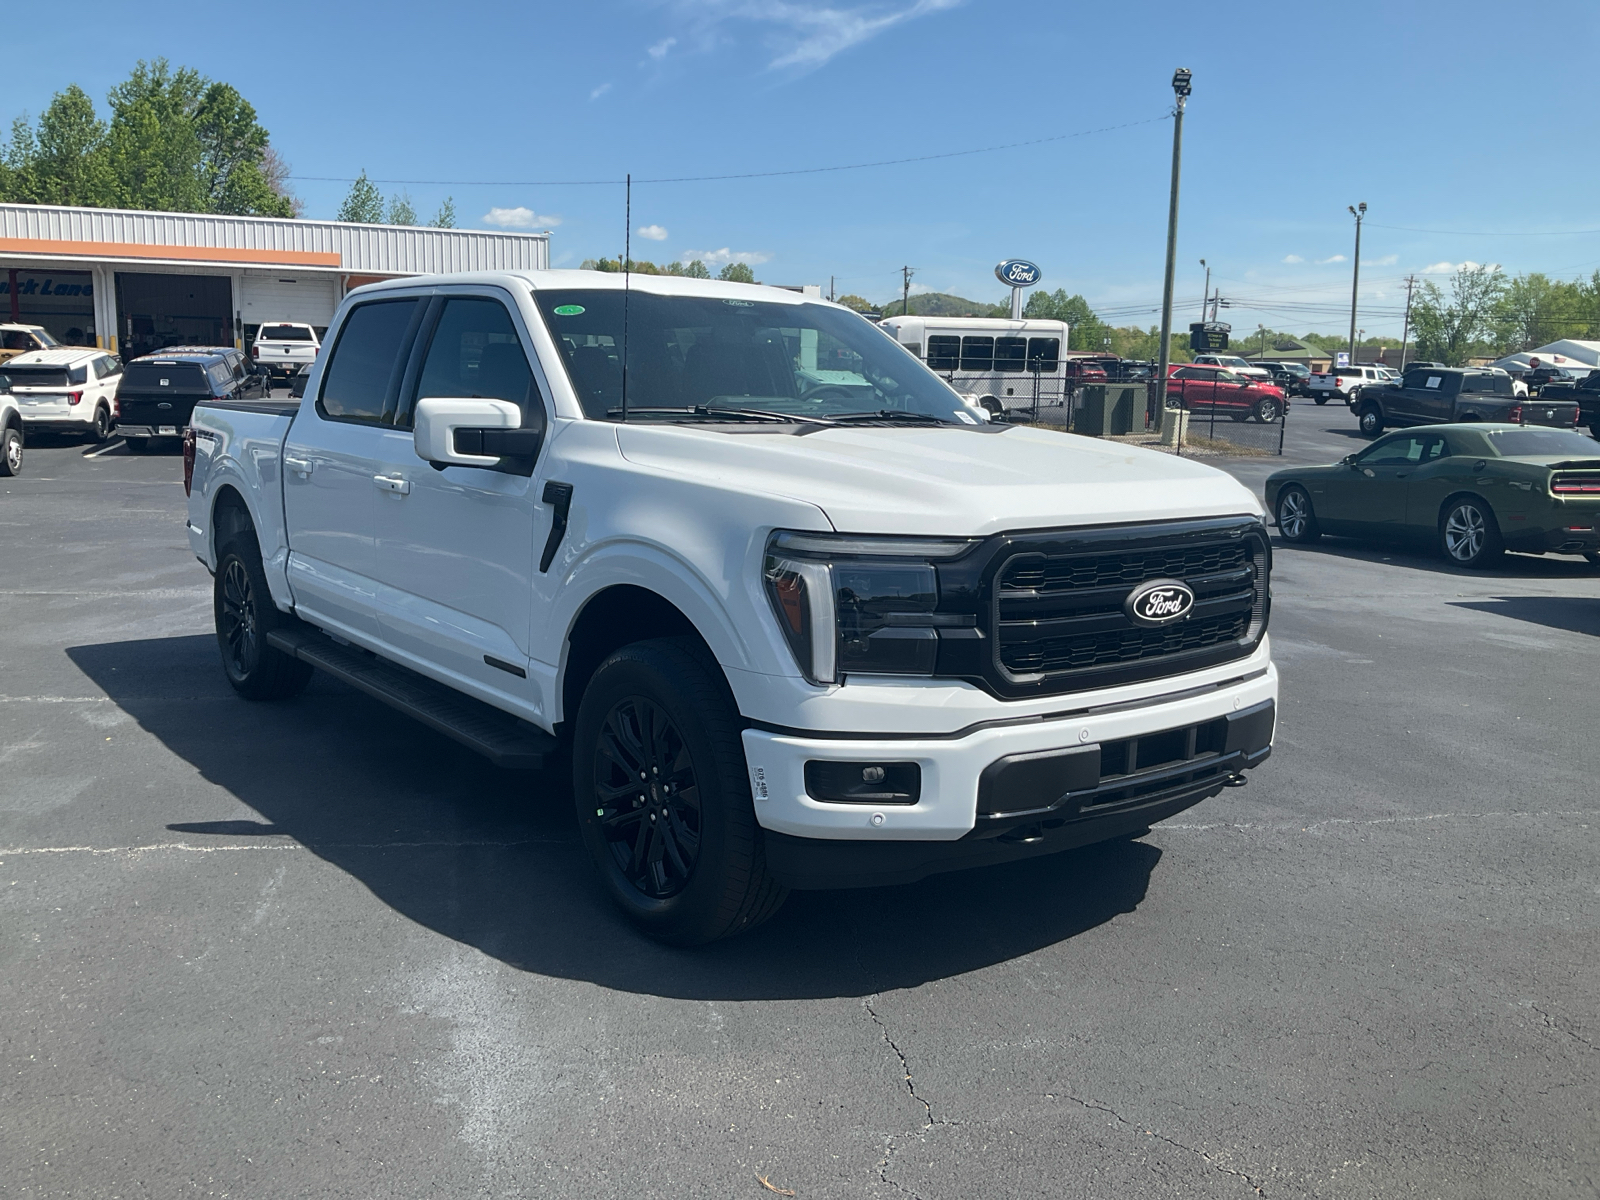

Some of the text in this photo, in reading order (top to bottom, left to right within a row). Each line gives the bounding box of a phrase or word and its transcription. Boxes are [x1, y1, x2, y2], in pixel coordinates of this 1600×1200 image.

[1009, 264, 1035, 281] Ford
[41, 279, 93, 296] Lane
[1145, 589, 1183, 616] Ford
